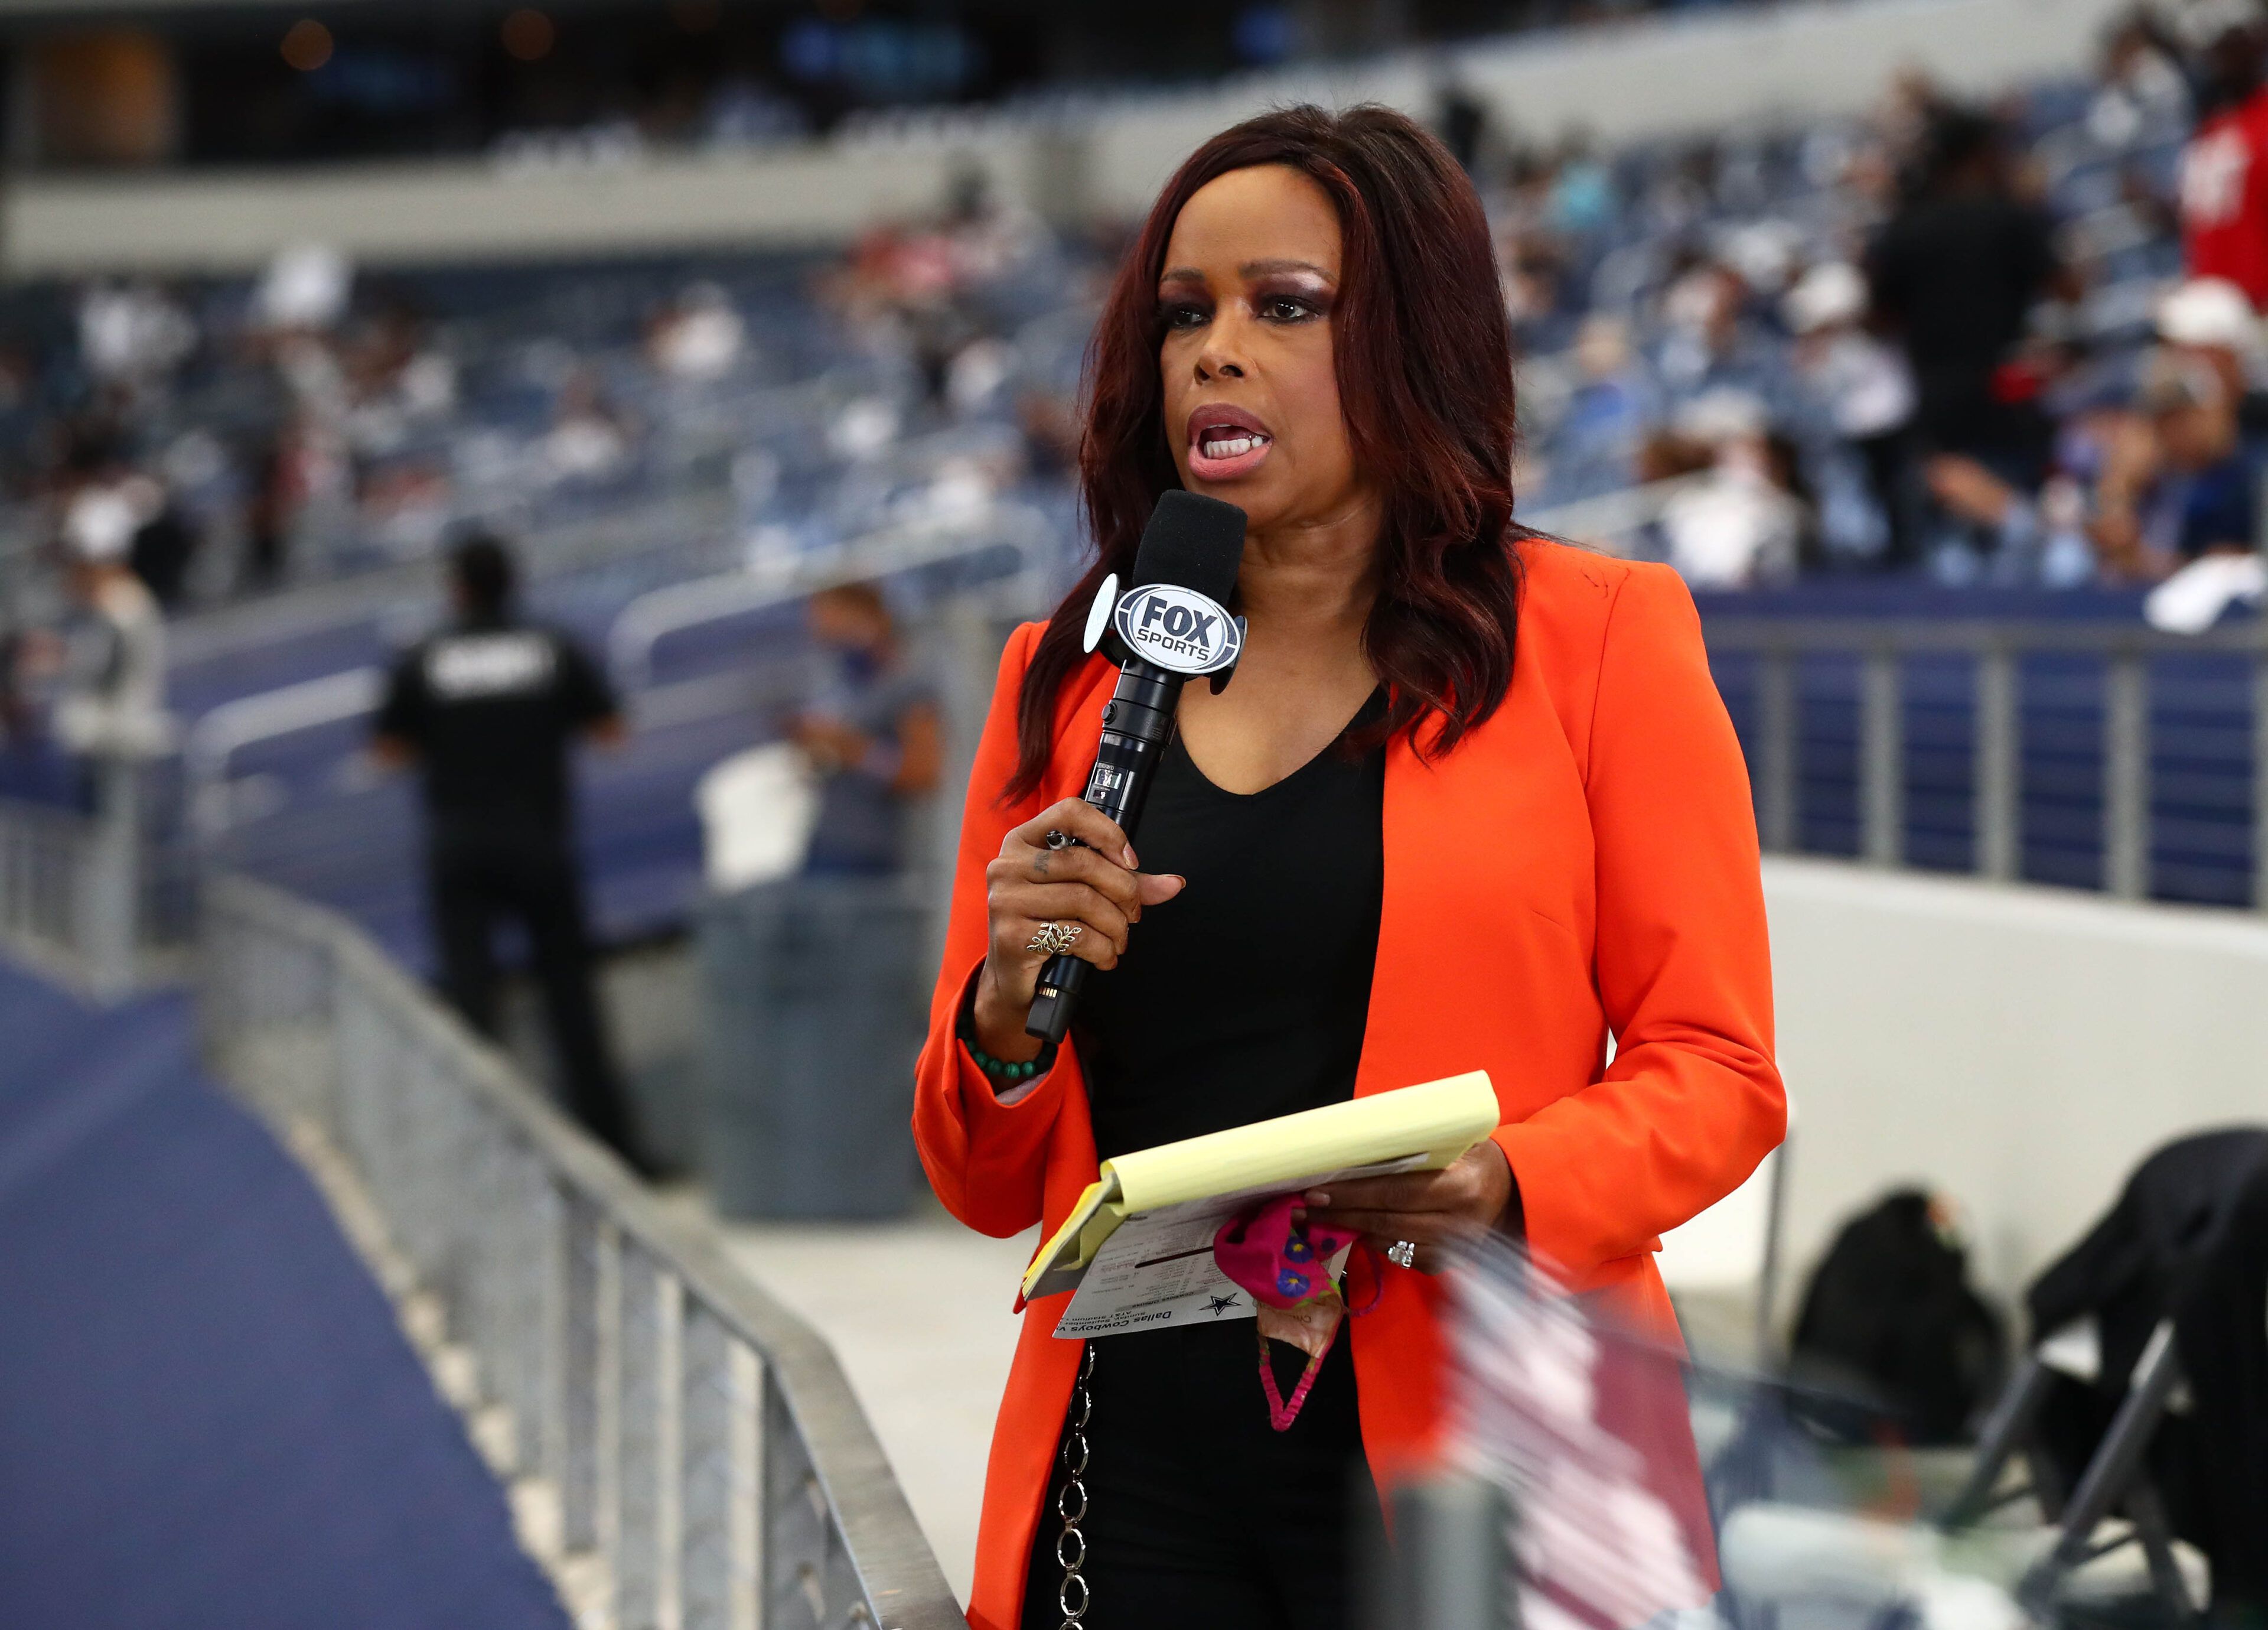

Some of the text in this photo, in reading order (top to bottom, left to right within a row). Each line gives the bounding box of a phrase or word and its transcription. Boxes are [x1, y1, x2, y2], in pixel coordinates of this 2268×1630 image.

[1141, 596, 1218, 648] FOX
[1136, 629, 1210, 662] SPORTS
[1071, 1320, 1129, 1332] Cowboys
[1133, 1311, 1172, 1323] Dallas
